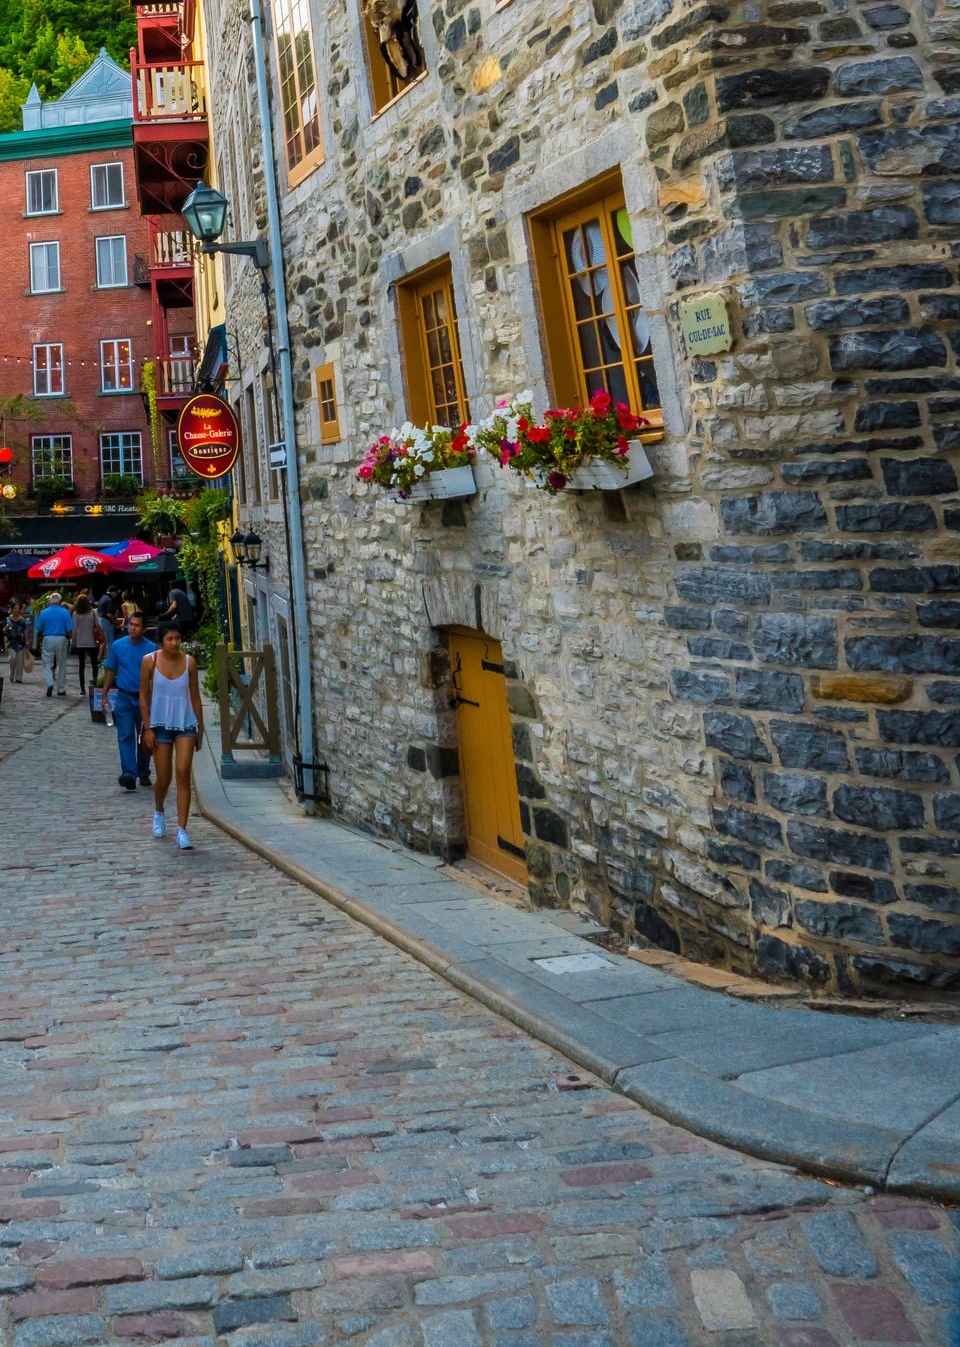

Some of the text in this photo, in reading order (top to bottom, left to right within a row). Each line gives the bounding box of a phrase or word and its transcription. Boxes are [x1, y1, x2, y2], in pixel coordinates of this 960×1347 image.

[695, 308, 712, 322] RUE
[688, 324, 726, 343] CUL-DE-SAC
[184, 429, 233, 440] Chasse-Galerie
[193, 446, 227, 455] Boutique
